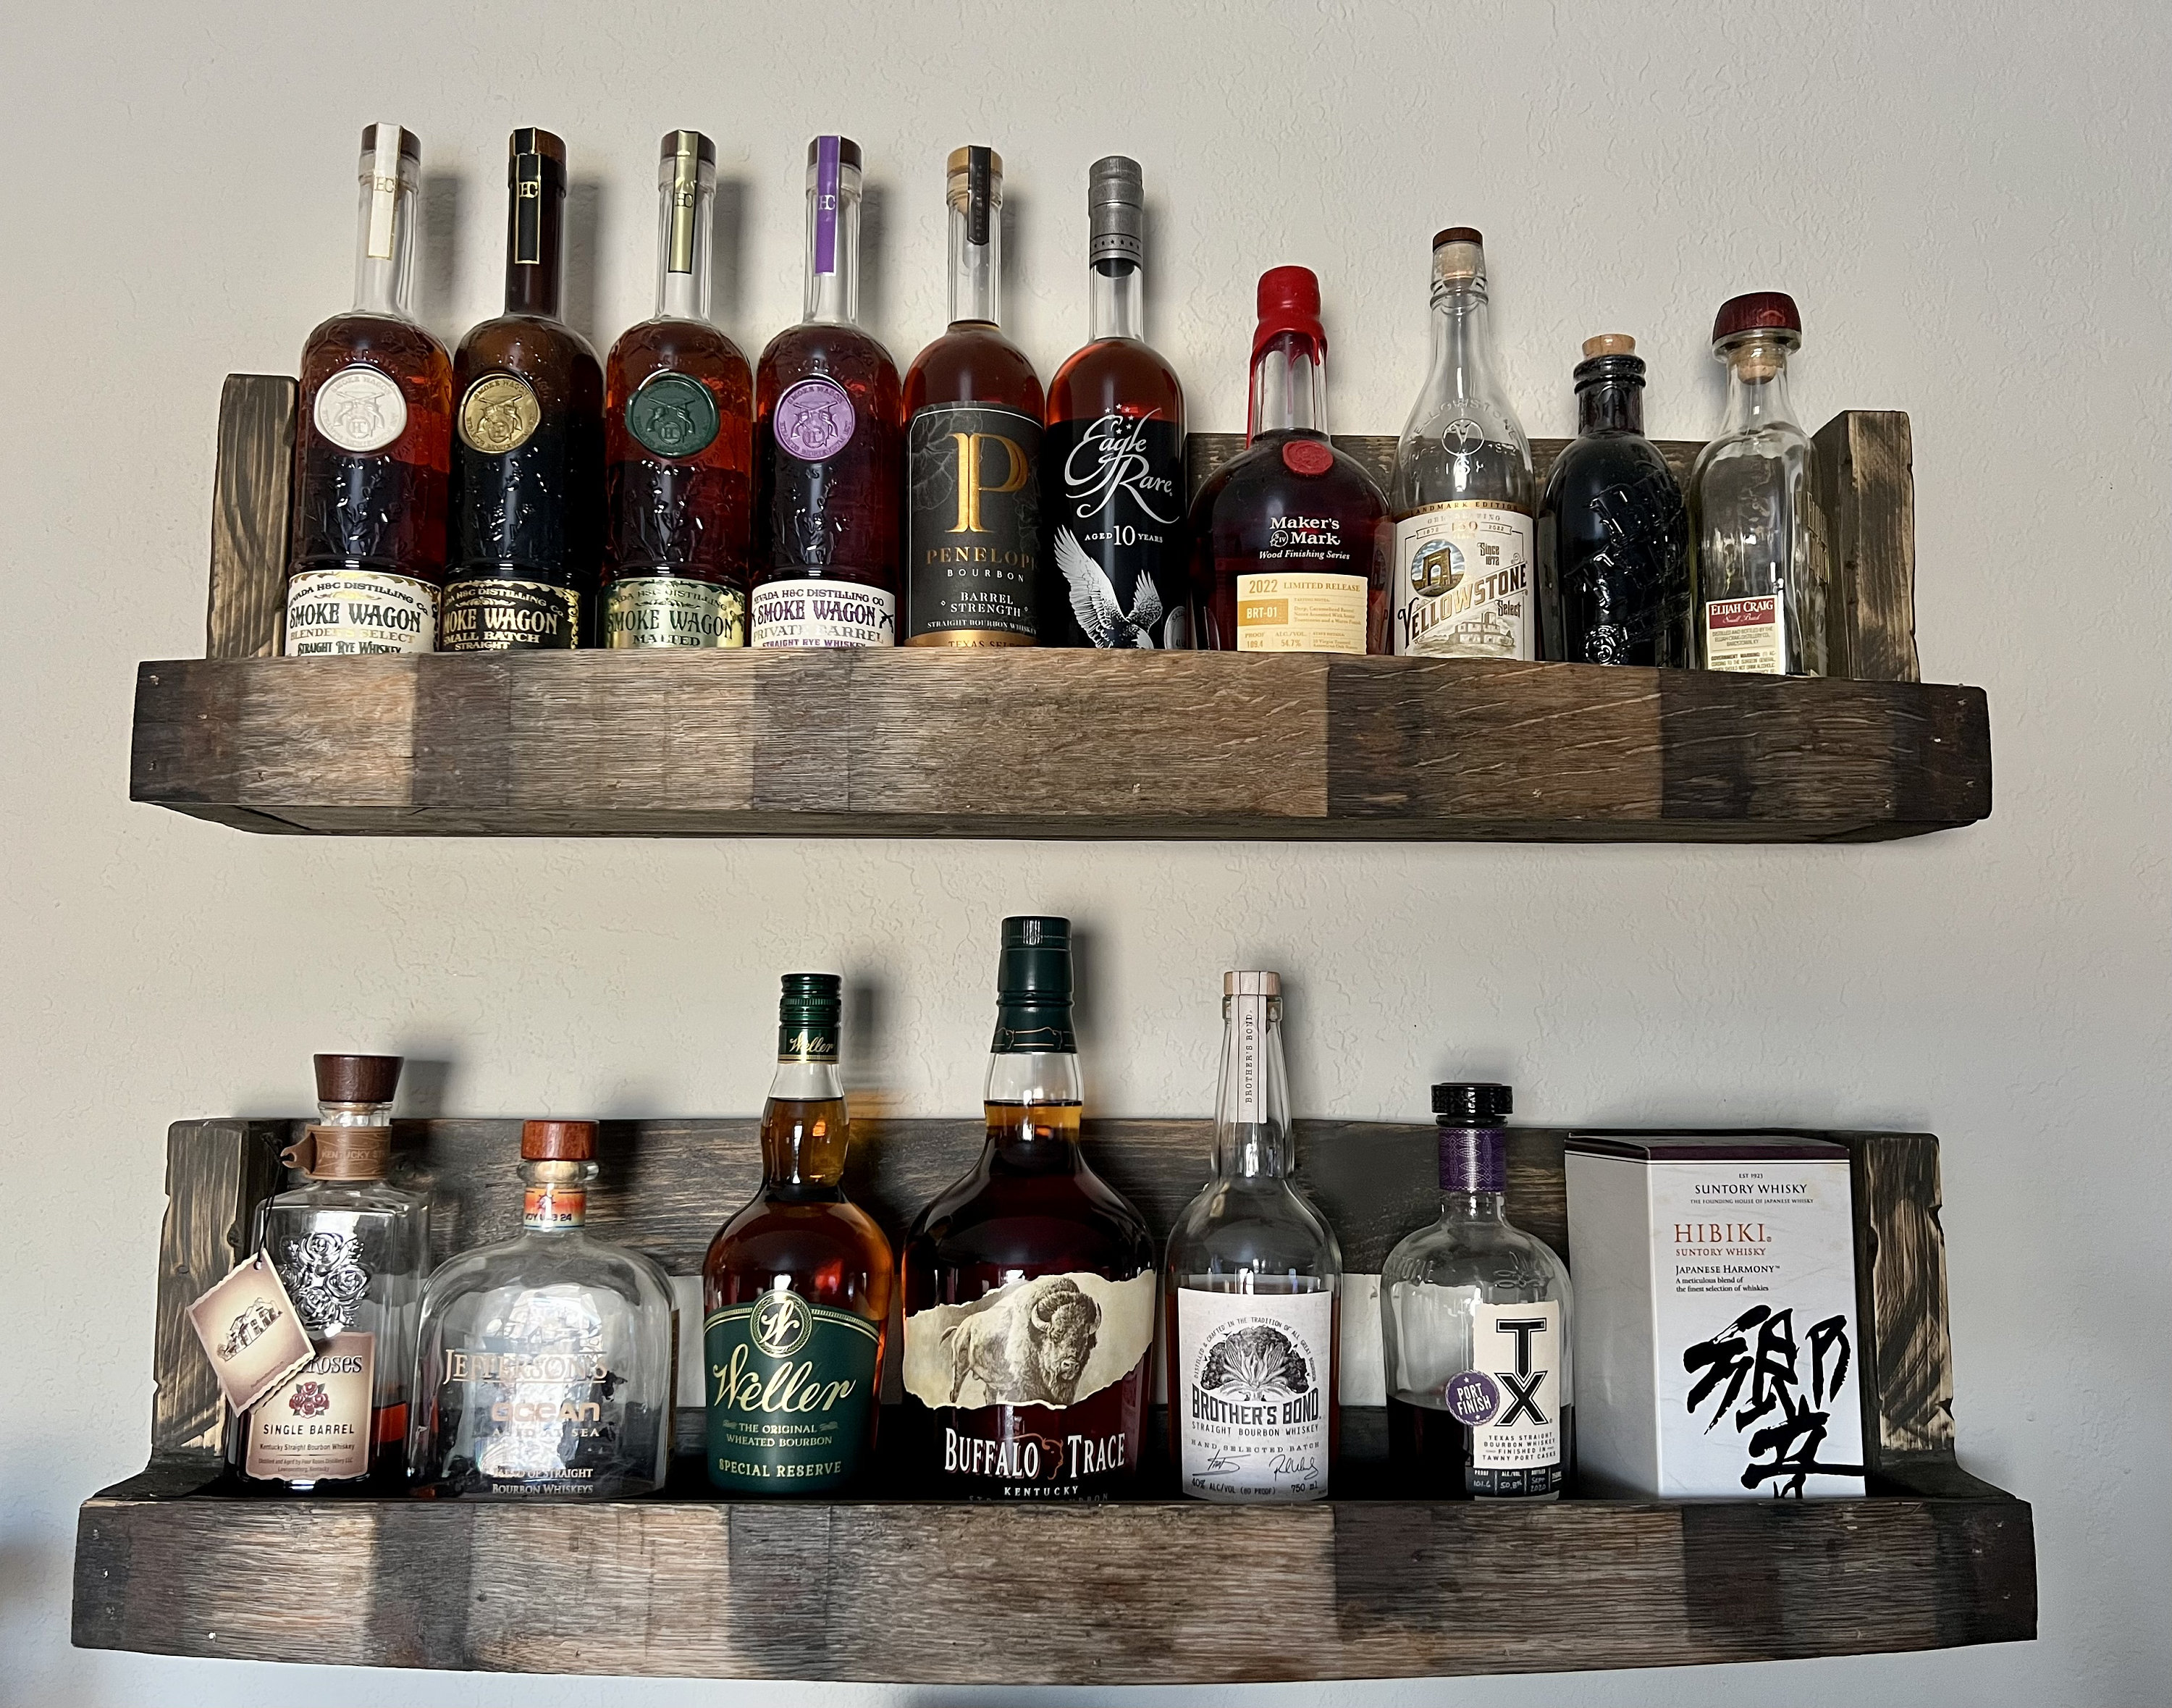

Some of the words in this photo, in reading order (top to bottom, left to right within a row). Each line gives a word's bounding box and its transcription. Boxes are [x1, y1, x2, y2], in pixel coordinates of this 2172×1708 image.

[1064, 408, 1161, 498] Eagle
[944, 432, 1029, 533] P
[1077, 453, 1179, 523] Rare
[1269, 516, 1339, 530] Maker's
[1085, 532, 1113, 541] AGED
[1113, 525, 1135, 546] 10
[1137, 533, 1163, 544] YEARS
[1290, 531, 1341, 545] Mark
[1259, 550, 1283, 560] Wood
[1284, 550, 1325, 560] Finishing
[1326, 550, 1350, 560] Series
[947, 568, 1024, 583] BOURBON
[344, 582, 413, 604] DISTILLING
[1249, 579, 1278, 594] 2022
[478, 588, 547, 607] DISTILLING
[807, 589, 870, 602] DISTILLING
[961, 592, 1014, 605] BARREL
[951, 602, 1021, 618] STRENGTH
[1246, 607, 1278, 619] BRT-01
[1397, 563, 1527, 649] YELLOWSTONE
[1494, 600, 1521, 618] Select
[1711, 602, 1740, 615] ELIJAH
[1743, 600, 1774, 613] CRAIG
[290, 602, 340, 629] SMOKE
[349, 603, 421, 633] WAGON
[758, 600, 805, 625] SMOKE
[812, 600, 875, 627] WAGON
[484, 607, 558, 635] WAGON
[607, 609, 660, 634] SMOKE
[670, 610, 733, 639] WAGON
[927, 619, 967, 629] STRAIGHT
[969, 619, 1008, 629] BOURBON
[360, 629, 416, 643] SELECT
[484, 631, 541, 643] BATCH
[633, 634, 701, 646] MALTED
[298, 642, 332, 655] STRAIGHT
[336, 641, 355, 653] RYE
[455, 641, 510, 651] STRAIGHT
[1695, 1184, 1754, 1194] SUNTORY
[1758, 1184, 1807, 1194] WHISKY
[1674, 1223, 1767, 1242] HIBIKI
[1726, 1248, 1766, 1256] WHISKY
[1675, 1266, 1720, 1276] JAPANESE
[1194, 1348, 1205, 1379] DISTILLED
[1207, 1324, 1226, 1342] CRAFTED
[1251, 1317, 1282, 1328] TRADITION
[713, 1343, 856, 1413] Weller
[1457, 1383, 1483, 1402] PORT
[1192, 1383, 1277, 1425] BROTHER'S
[1457, 1395, 1491, 1416] FINISH
[264, 1424, 303, 1435] SINGLE
[310, 1423, 355, 1434] BARREL
[572, 1428, 599, 1437] SEA
[739, 1423, 759, 1433] THE
[762, 1423, 817, 1434] ORIGINAL
[1192, 1421, 1232, 1435] STRAIGHT
[1239, 1428, 1280, 1436] BOURBON
[1286, 1423, 1319, 1435] WHISKEY
[726, 1434, 775, 1447] WHEATED
[779, 1436, 832, 1447] BOURBON
[1519, 1432, 1552, 1441] STRAIGHT
[1527, 1438, 1555, 1447] WHISKEY
[945, 1427, 1040, 1478] BUFFALO
[1068, 1433, 1125, 1478] TRACE
[1191, 1439, 1217, 1449] HAND
[1223, 1444, 1284, 1453] SELECTED
[1289, 1442, 1320, 1452] BATCH
[719, 1458, 770, 1477] SPECIAL
[777, 1461, 841, 1478] RESERVE
[492, 1484, 540, 1494] BOURBON
[543, 1484, 594, 1494] WHISKEYS
[1004, 1485, 1079, 1497] KENTUCKY
[1209, 1484, 1235, 1494] ALC/VOL
[1291, 1484, 1305, 1493] 750
